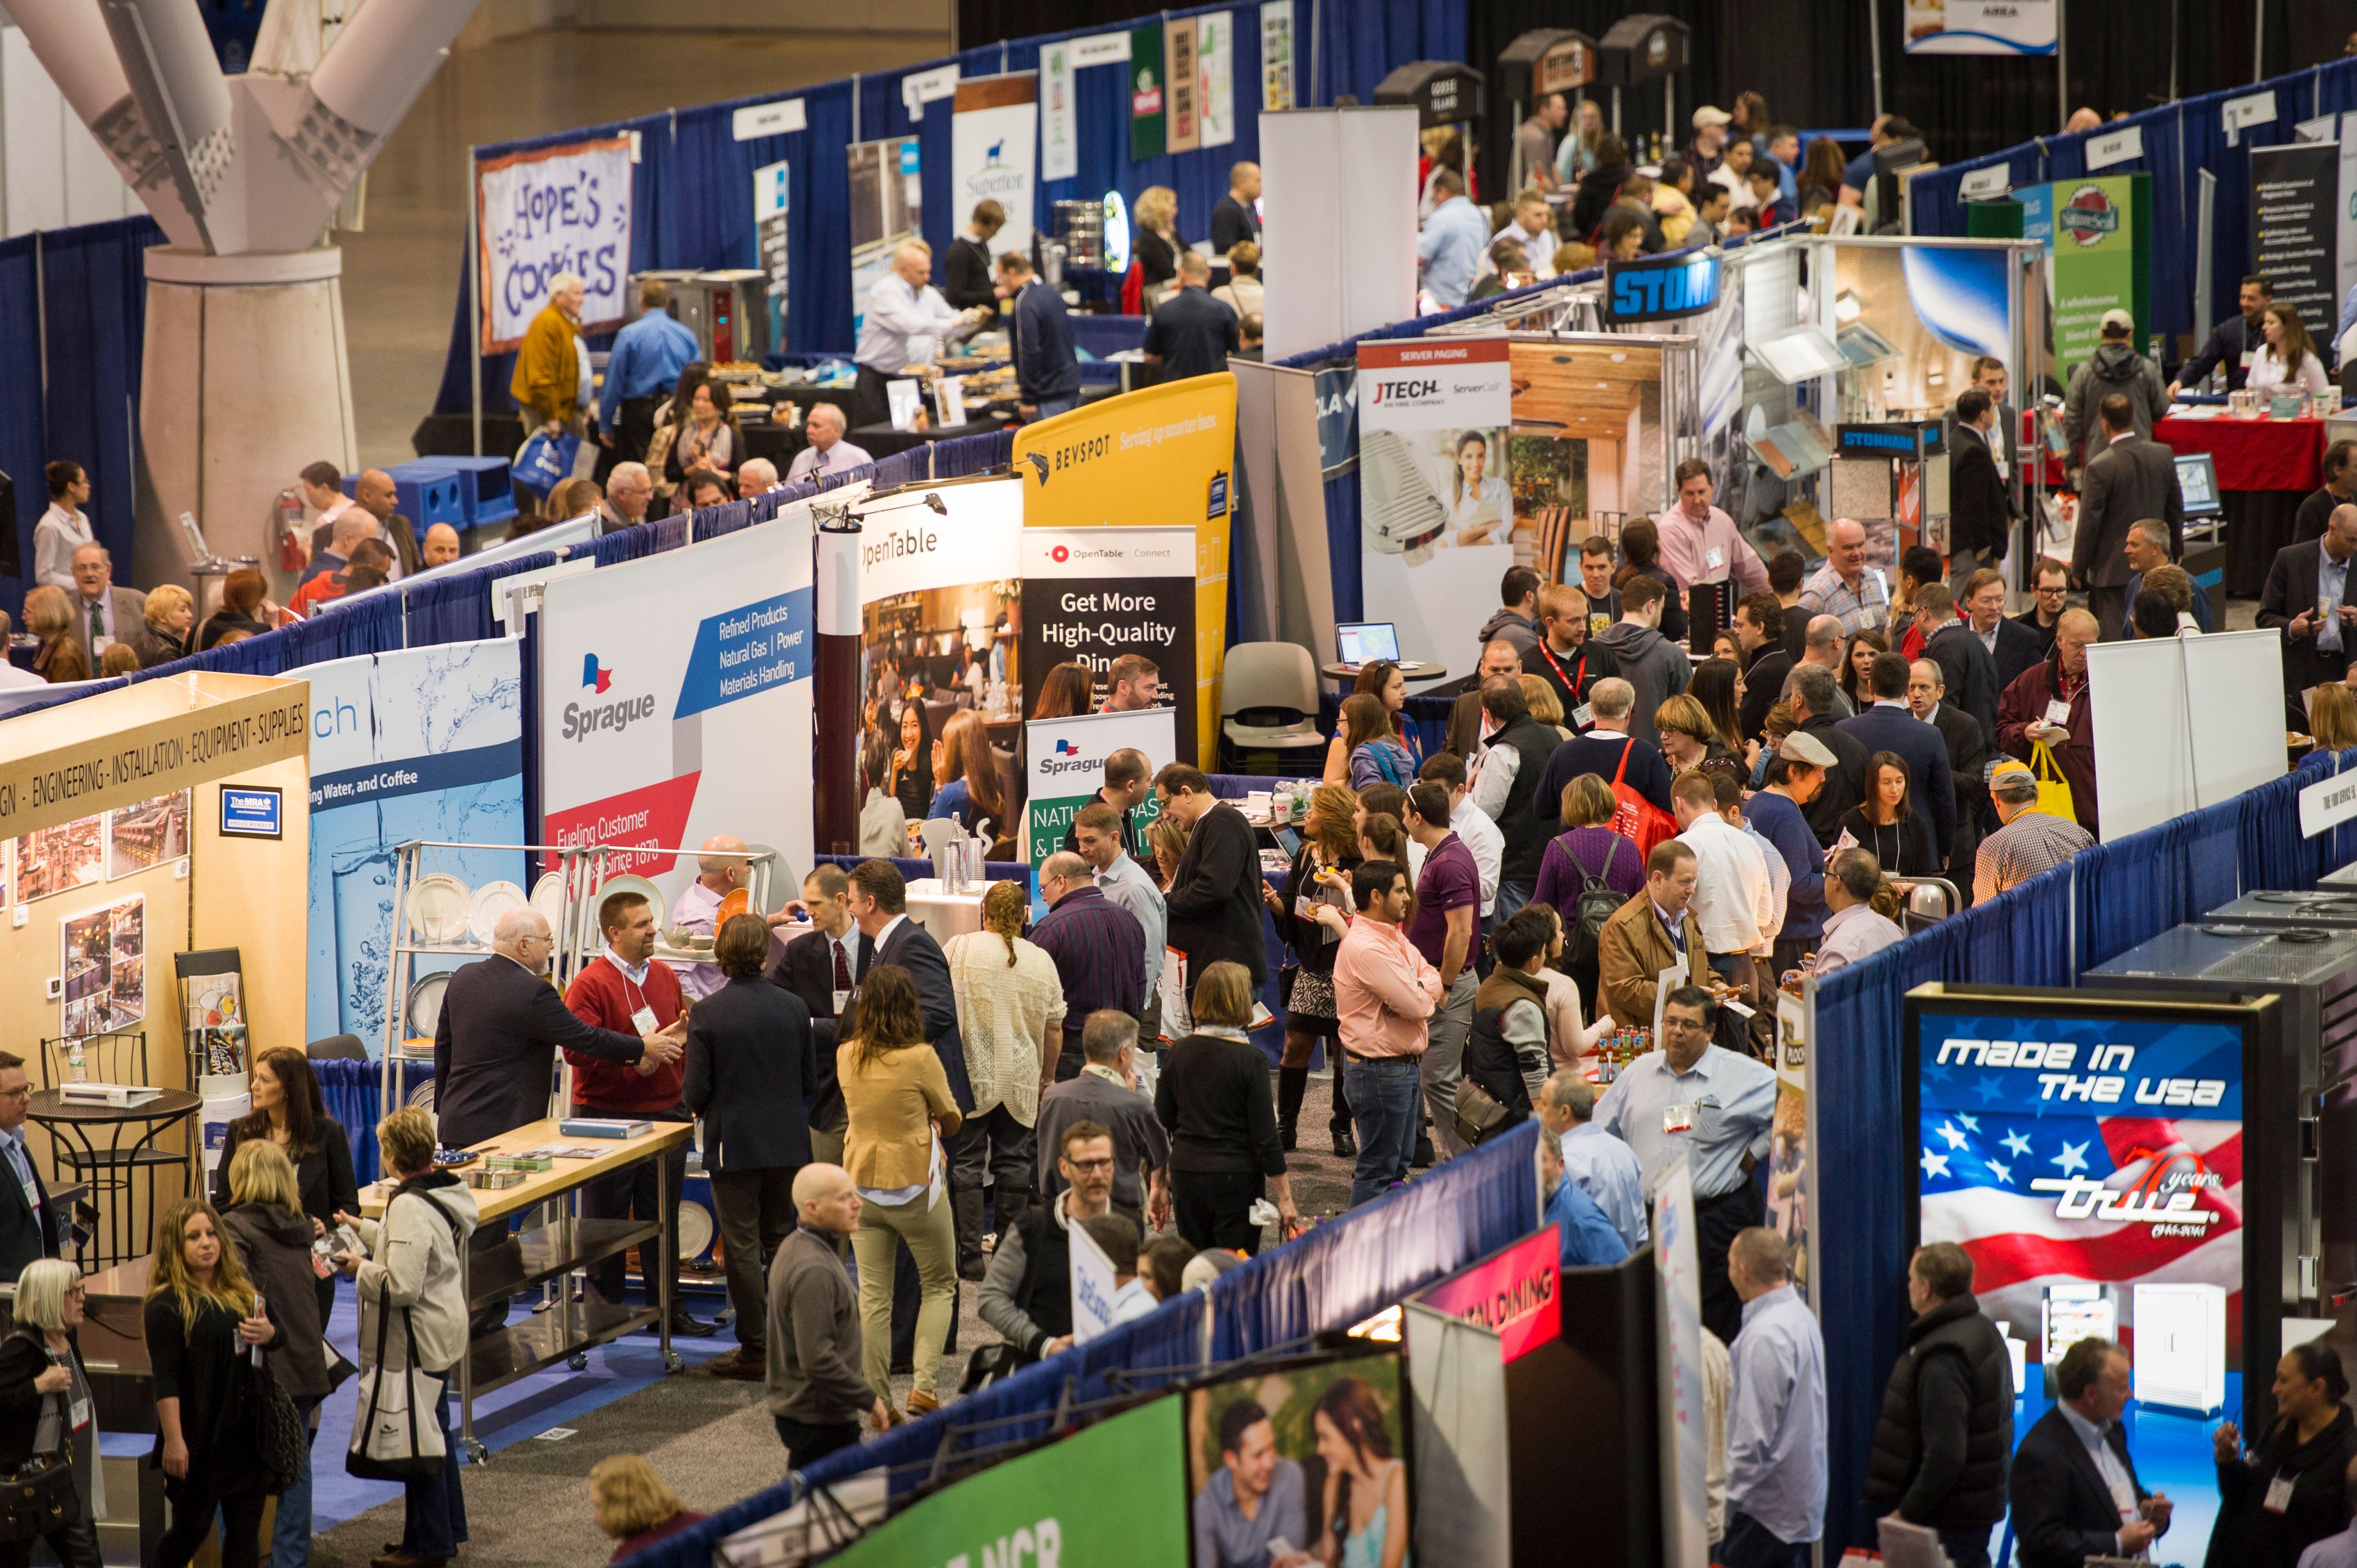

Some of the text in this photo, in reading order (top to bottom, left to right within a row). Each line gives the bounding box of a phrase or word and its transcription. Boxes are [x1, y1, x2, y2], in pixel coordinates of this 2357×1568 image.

[514, 169, 601, 239] HOPE'S
[966, 173, 1023, 200] Superior
[1400, 348, 1467, 362] SERVER PAGING
[1373, 379, 1440, 404] JTECH
[1119, 427, 1152, 450] Serving
[1153, 426, 1163, 443] up
[1165, 417, 1197, 438] smarter
[1056, 434, 1110, 471] BEVSPOT
[863, 528, 938, 574] penTable
[1074, 549, 1170, 559] OpenTable Connect
[1061, 592, 1156, 612] Get More
[719, 605, 788, 641] Refined Products
[1042, 621, 1176, 648] High-Quality
[719, 628, 804, 669] Natural Gas Power
[720, 660, 795, 697] Materials Handling
[562, 693, 655, 744] Sprague
[33, 759, 104, 808] ENGINEERING
[112, 739, 184, 786] INSTALLATION
[192, 718, 252, 763] EQUIPMENT
[258, 703, 304, 745] SUPPLIES
[310, 770, 418, 805] ing Water, and Coffee
[558, 809, 649, 849] Fueling Customer
[635, 838, 659, 866] 1870
[209, 1045, 223, 1075] RESERV
